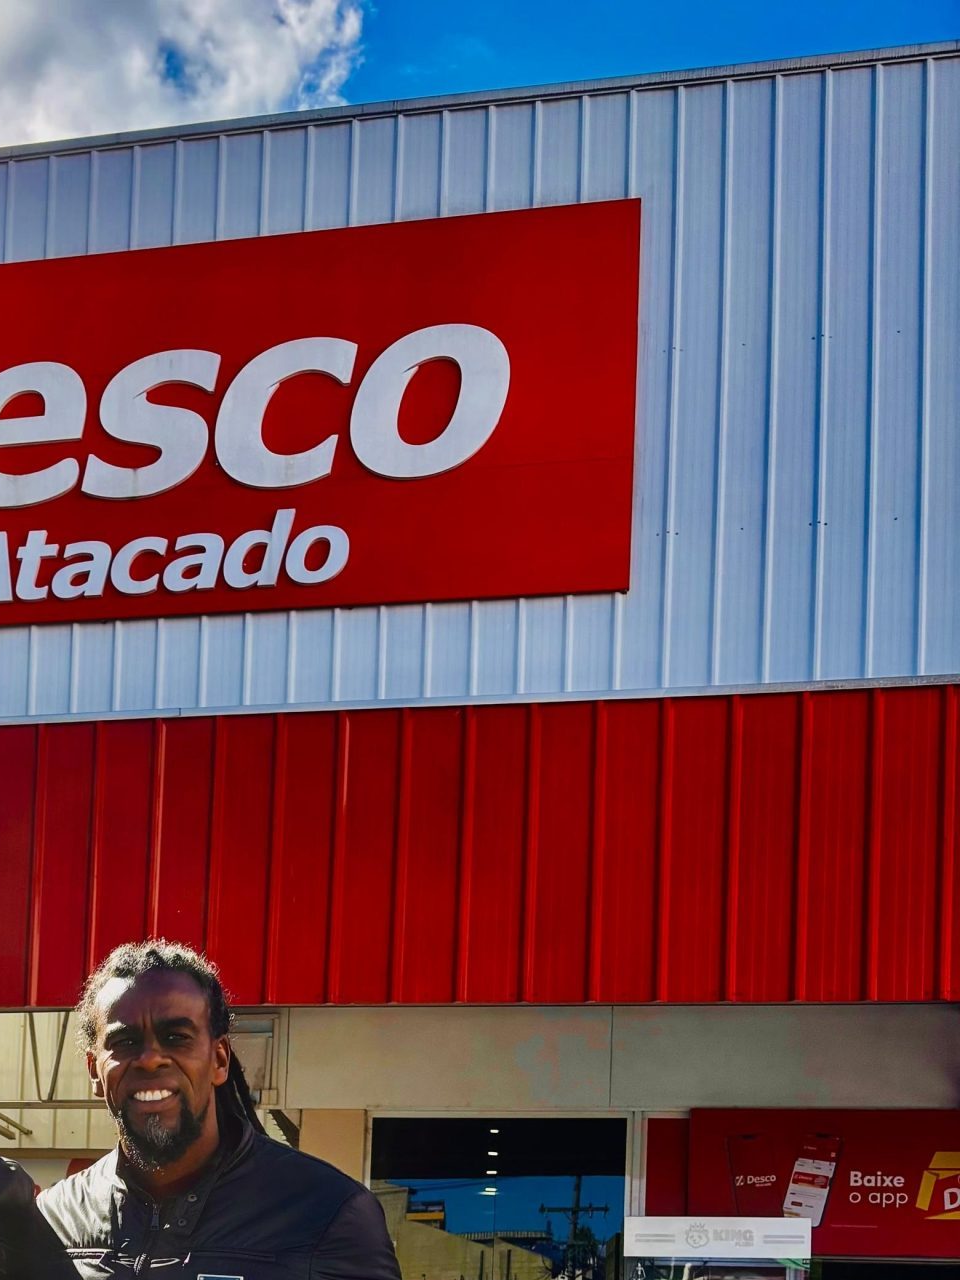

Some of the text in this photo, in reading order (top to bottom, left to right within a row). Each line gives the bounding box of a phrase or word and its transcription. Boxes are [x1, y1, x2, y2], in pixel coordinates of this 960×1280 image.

[746, 1175, 777, 1185] Desco
[849, 1171, 905, 1187] Baixe
[849, 1192, 909, 1208] o app
[712, 1229, 754, 1241] KING
